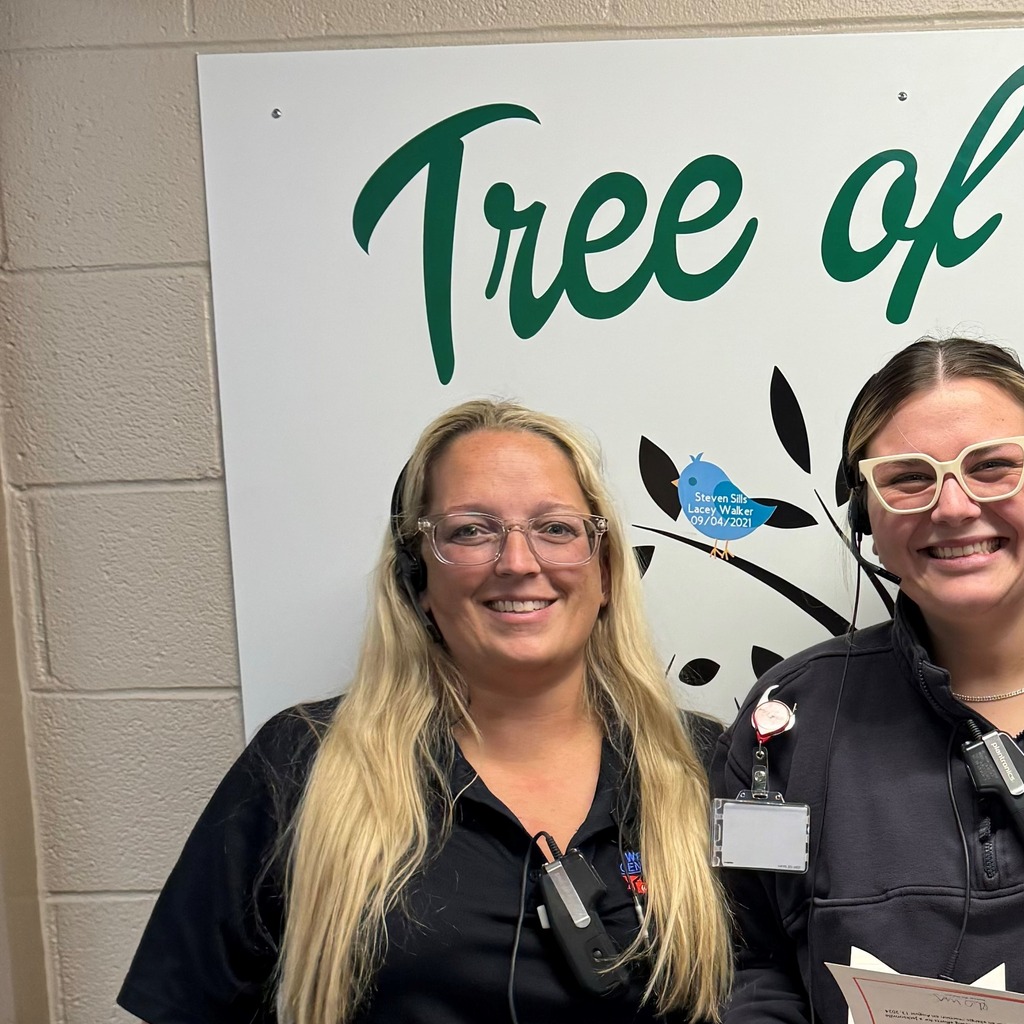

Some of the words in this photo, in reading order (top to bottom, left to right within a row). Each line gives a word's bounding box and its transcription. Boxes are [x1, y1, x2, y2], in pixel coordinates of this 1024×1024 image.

[352, 103, 758, 385] Tree
[695, 492, 728, 503] Steven
[730, 494, 748, 504] Sills
[688, 504, 716, 516] Lacey
[719, 505, 754, 516] Walker
[690, 516, 752, 528] 09/04/2021
[991, 742, 1015, 782] plantronics
